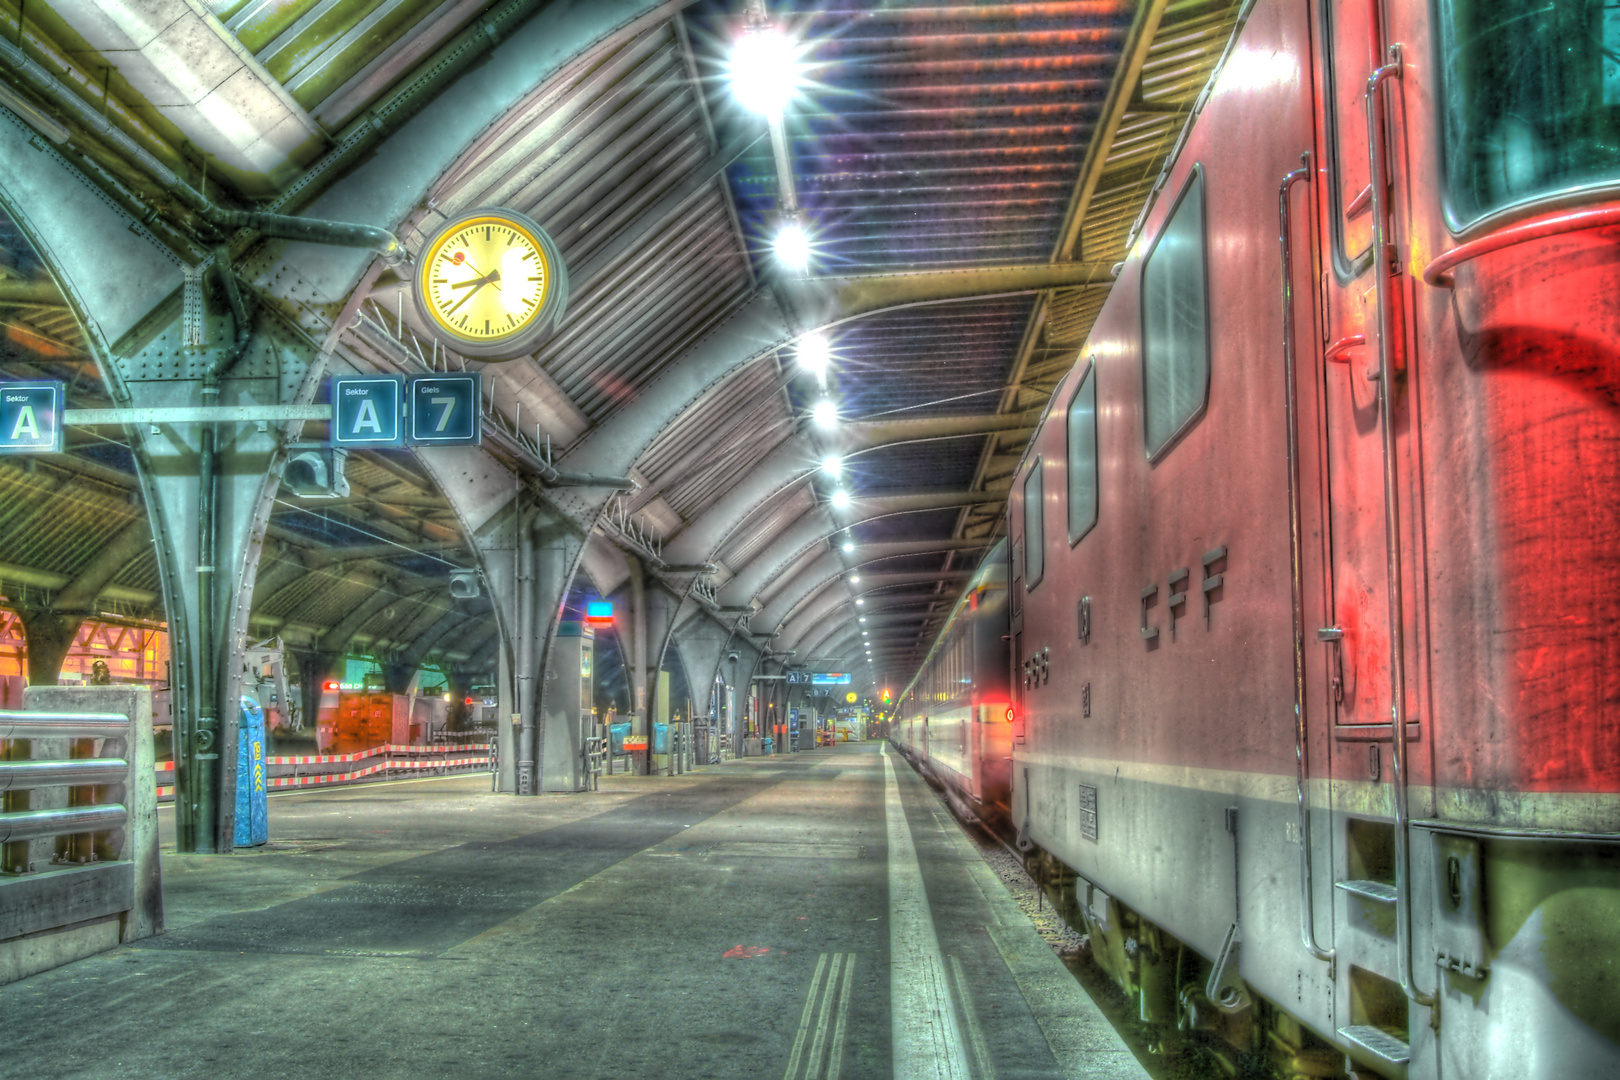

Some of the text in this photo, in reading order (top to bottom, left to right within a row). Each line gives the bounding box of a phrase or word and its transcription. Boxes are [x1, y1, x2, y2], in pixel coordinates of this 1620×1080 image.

[345, 388, 369, 396] Sektor
[421, 386, 440, 394] Gleis
[11, 405, 40, 440] A
[352, 399, 382, 434] A
[431, 397, 456, 432] 7
[1140, 544, 1228, 641] CFF
[789, 674, 796, 682] A
[803, 674, 809, 682] 7
